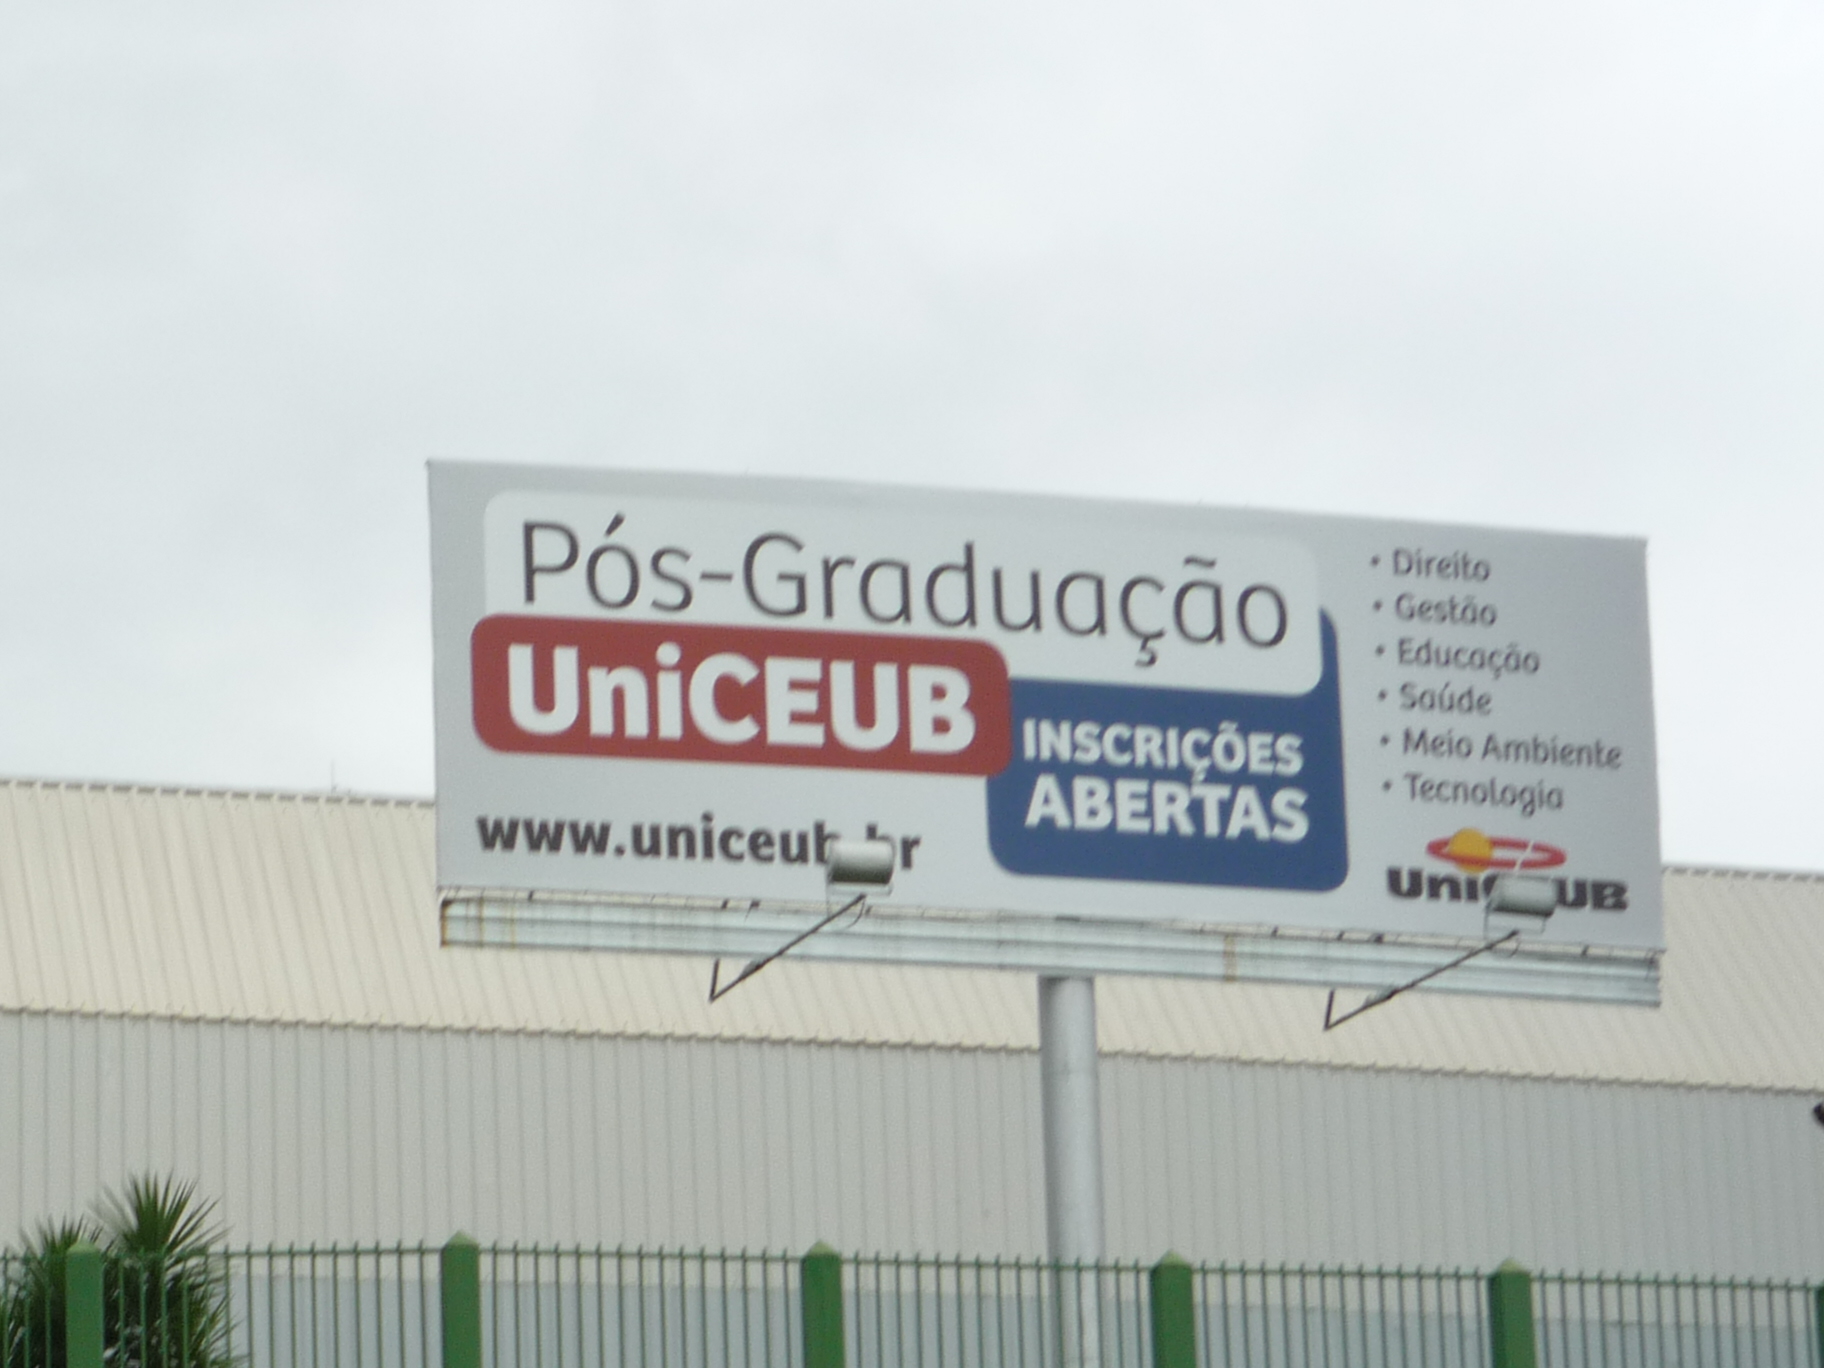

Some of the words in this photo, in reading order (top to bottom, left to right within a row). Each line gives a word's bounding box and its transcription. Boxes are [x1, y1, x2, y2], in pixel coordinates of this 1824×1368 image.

[1392, 548, 1491, 582] Direito
[522, 513, 1290, 668] Pós-Graduação
[1394, 591, 1498, 627] Gestão
[1397, 636, 1541, 680] Educação
[506, 640, 976, 755] UniCEUB
[1399, 681, 1492, 716] Saúde
[1021, 717, 1304, 779] INSCRIÇÕES
[1402, 727, 1474, 760] Meio
[1480, 732, 1622, 770] Ambiente
[1024, 775, 1310, 843] ABERTAS
[1403, 771, 1564, 819] Tecnologia
[1386, 866, 1629, 911] UniUB
